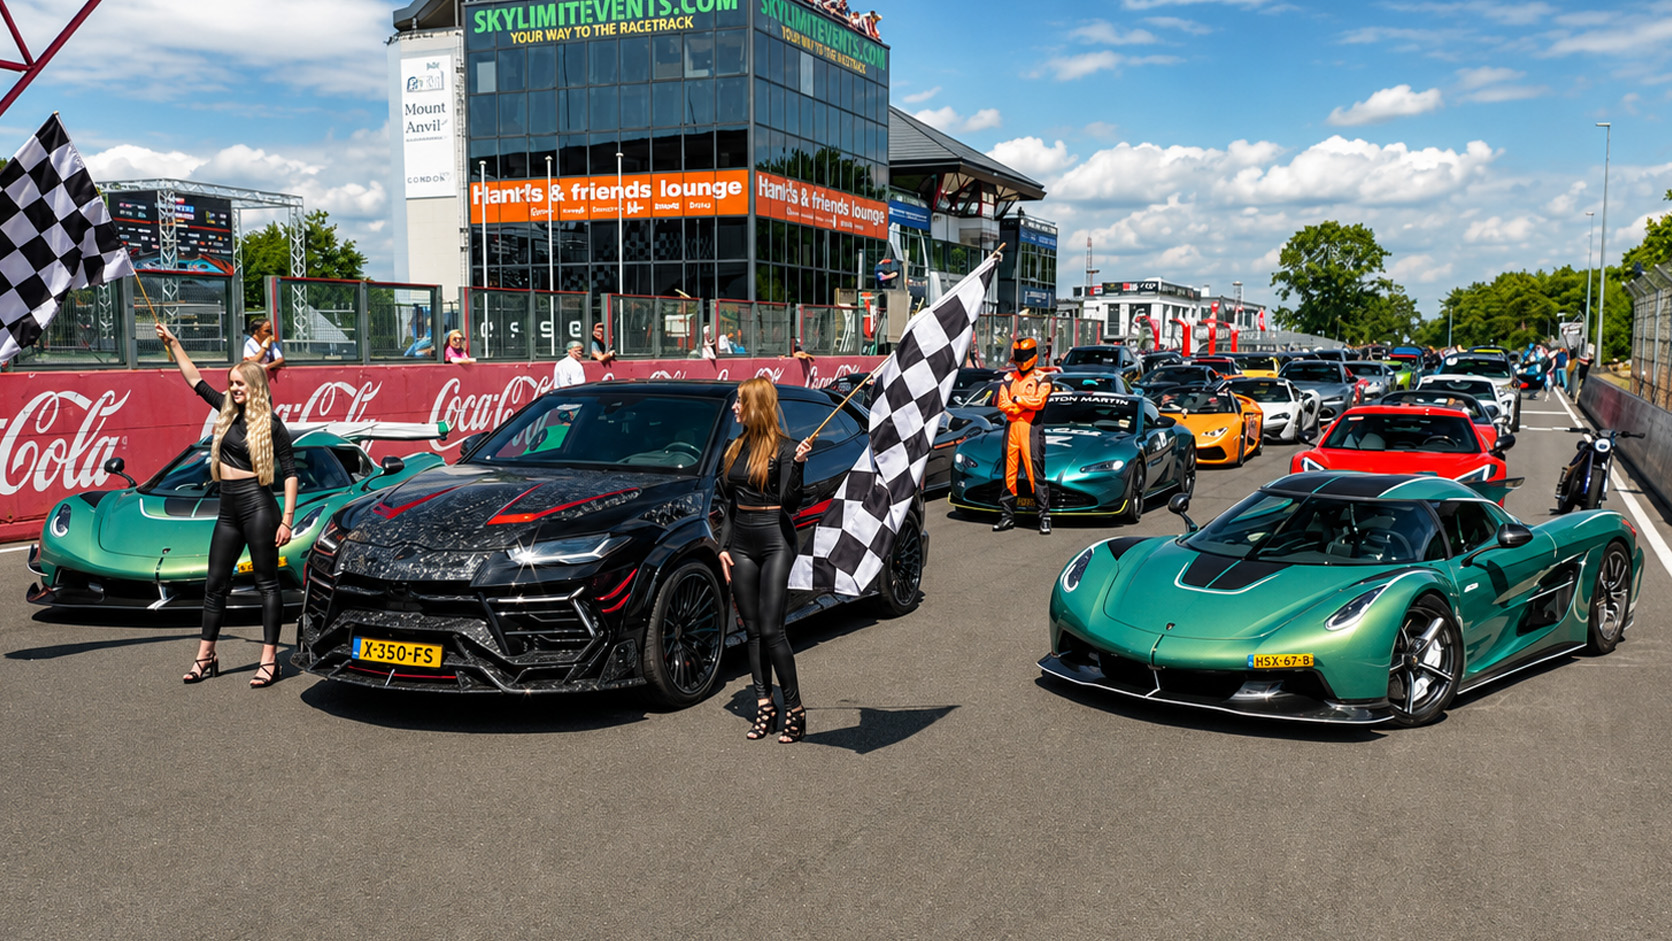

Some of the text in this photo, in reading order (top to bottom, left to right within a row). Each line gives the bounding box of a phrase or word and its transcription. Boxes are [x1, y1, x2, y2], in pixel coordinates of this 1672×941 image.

[510, 16, 694, 44] YOUR WAY TO THE RACETRACK
[405, 103, 446, 116] Mount
[406, 118, 441, 134] Anvil
[551, 184, 565, 202] &
[571, 181, 652, 201] friends
[660, 180, 743, 200] lounge
[801, 187, 810, 208] &
[812, 191, 849, 216] friends
[852, 200, 885, 226] lounge
[1080, 396, 1129, 406] MARTIN
[429, 376, 555, 451] Coca-Cl
[363, 641, 433, 664] X-350-FS
[1255, 655, 1310, 667] HSX-67-B
